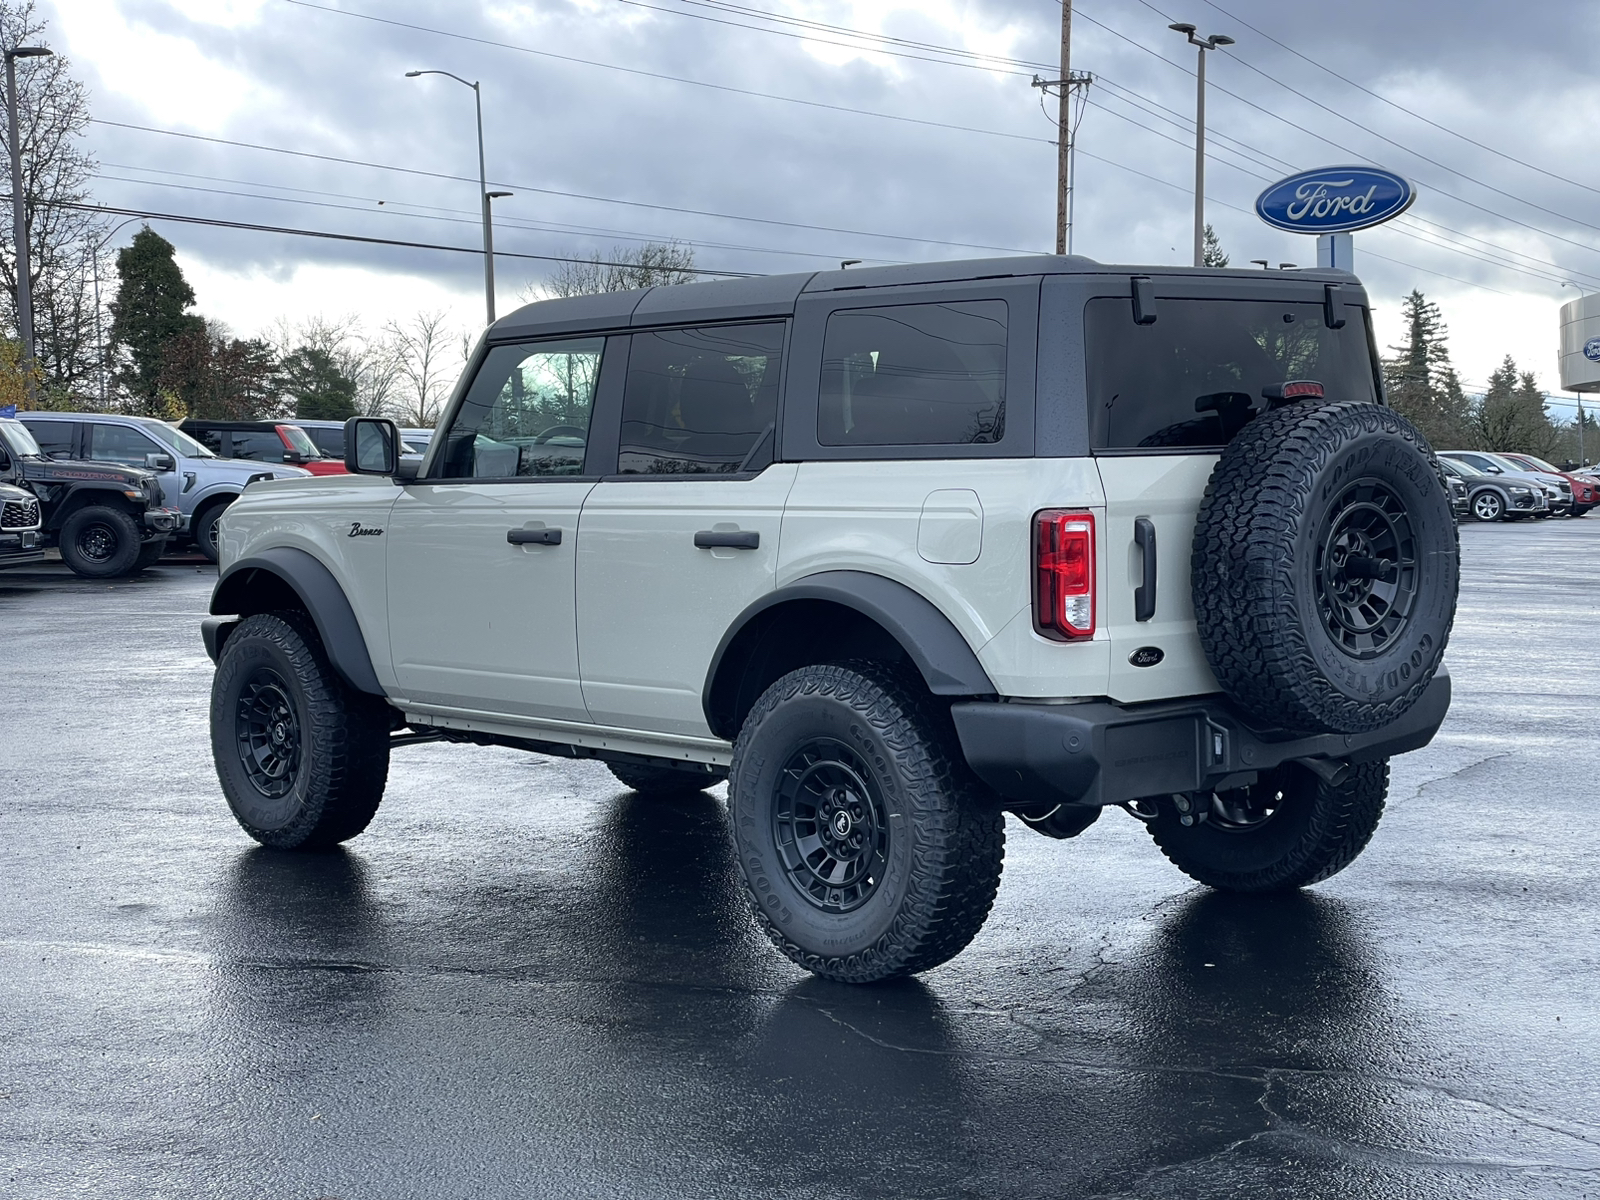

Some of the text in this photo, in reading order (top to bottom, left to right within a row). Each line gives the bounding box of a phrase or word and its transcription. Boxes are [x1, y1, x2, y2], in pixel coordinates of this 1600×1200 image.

[1286, 179, 1377, 220] Ford
[347, 522, 384, 537] Bronco
[1137, 651, 1158, 663] Ford
[739, 749, 794, 926] GOODYEAR
